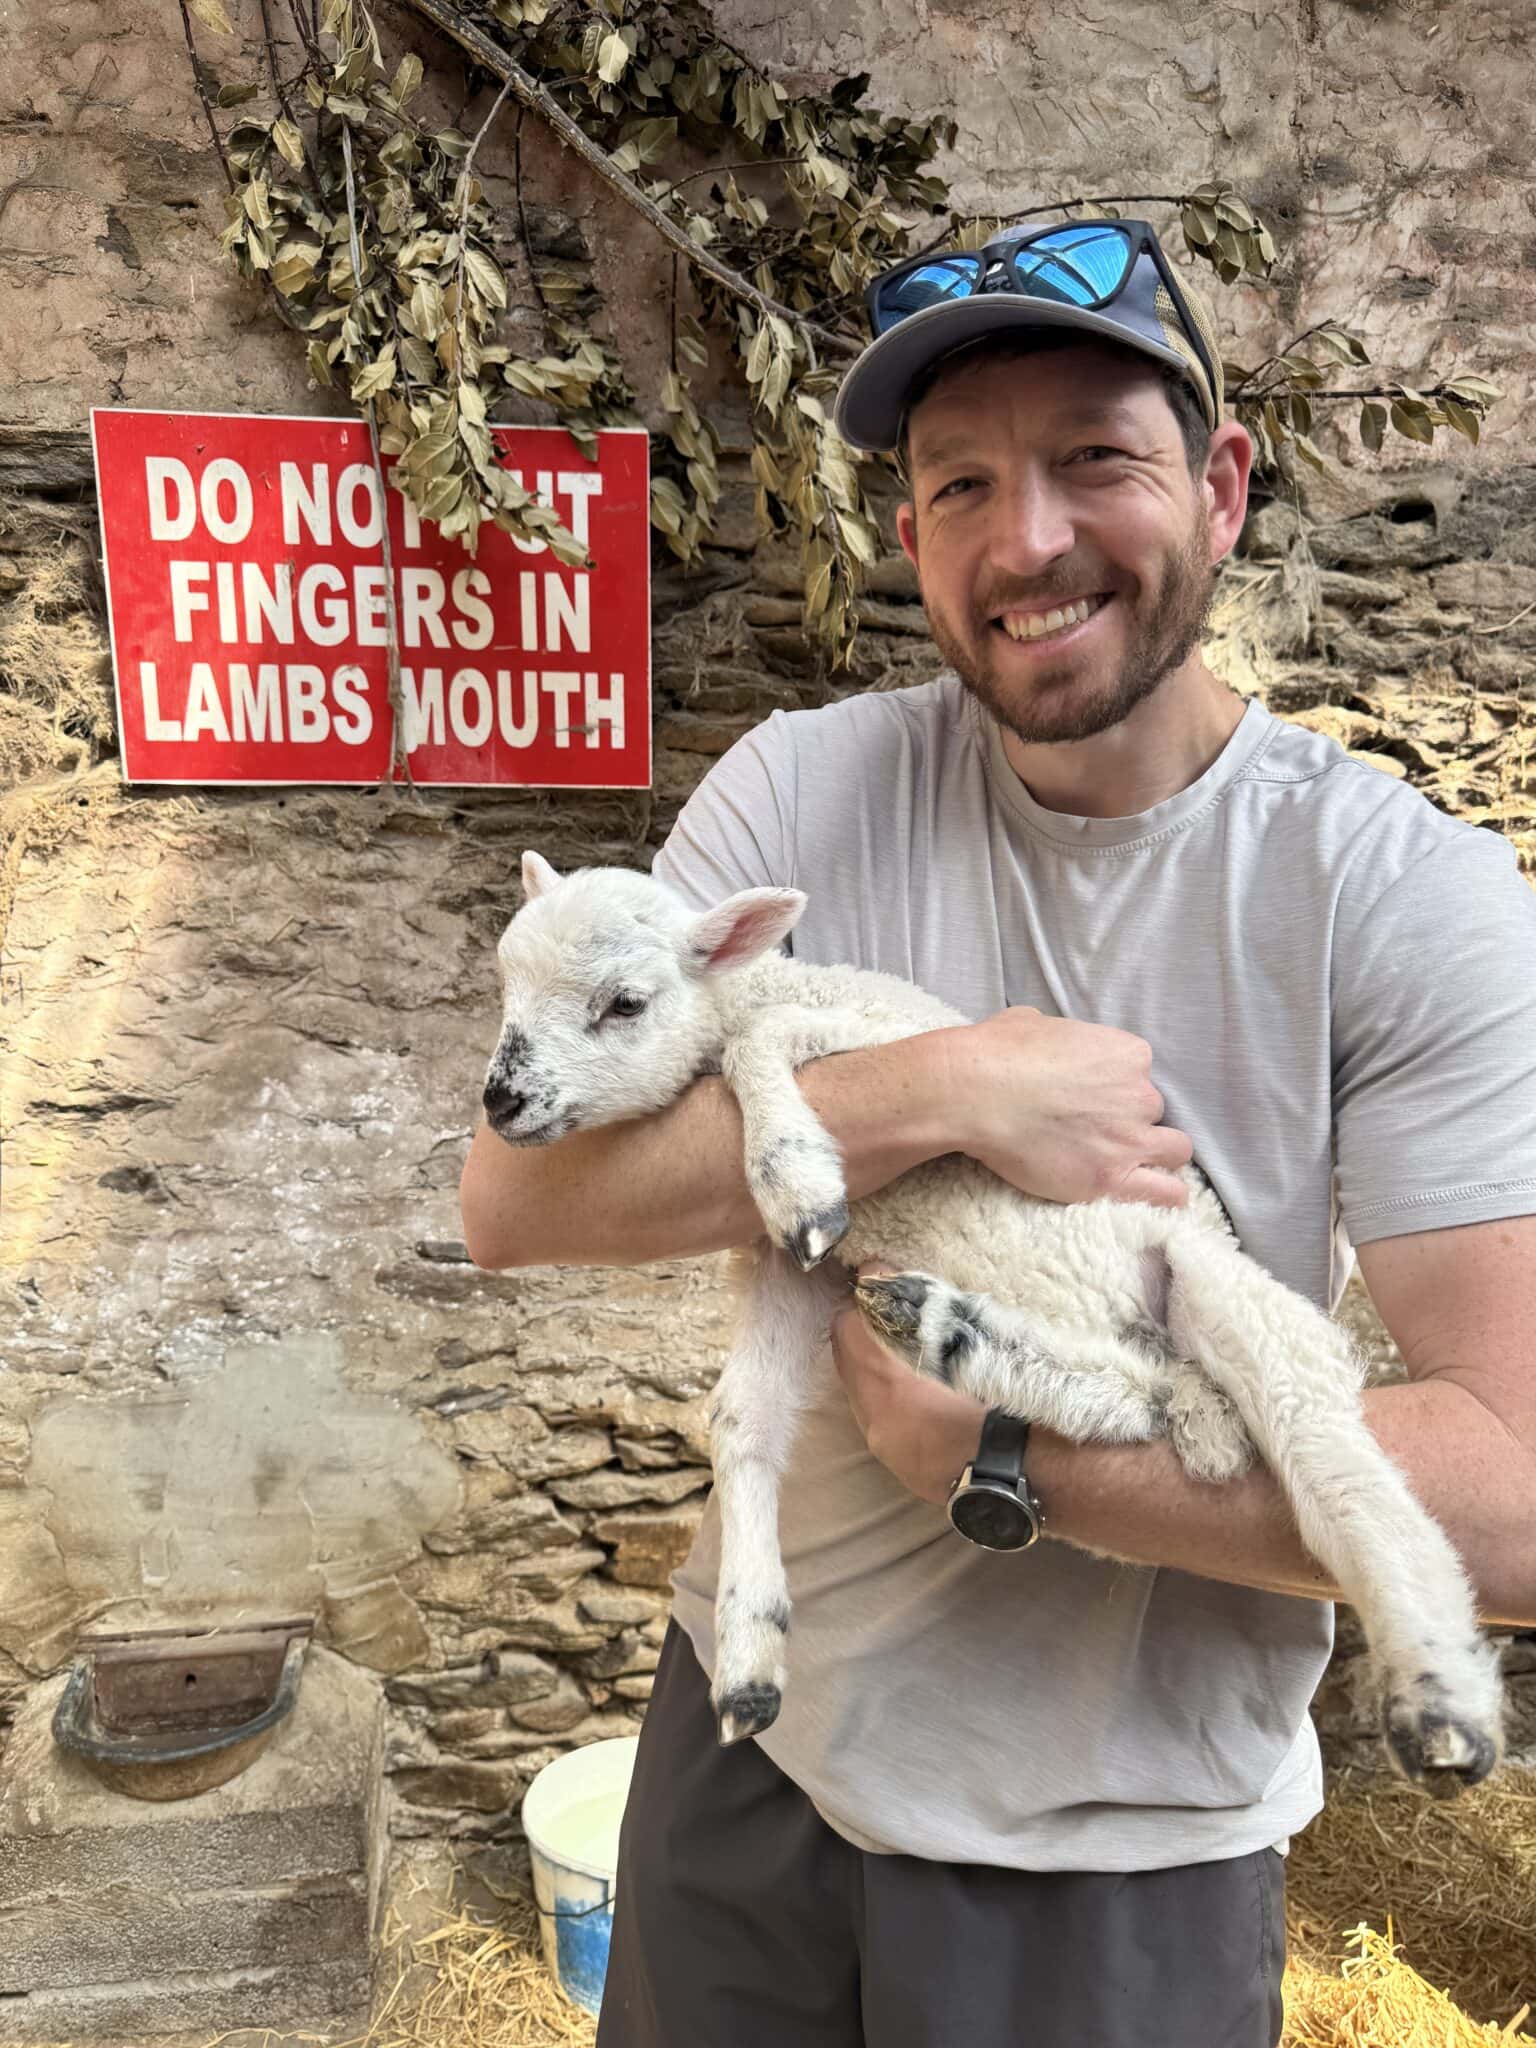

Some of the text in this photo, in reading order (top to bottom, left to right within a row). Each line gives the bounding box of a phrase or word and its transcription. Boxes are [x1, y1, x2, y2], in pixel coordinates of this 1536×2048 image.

[144, 455, 254, 545] DO
[168, 559, 592, 653] FINGERS IN
[139, 661, 626, 751] LAMBS MOUTH
